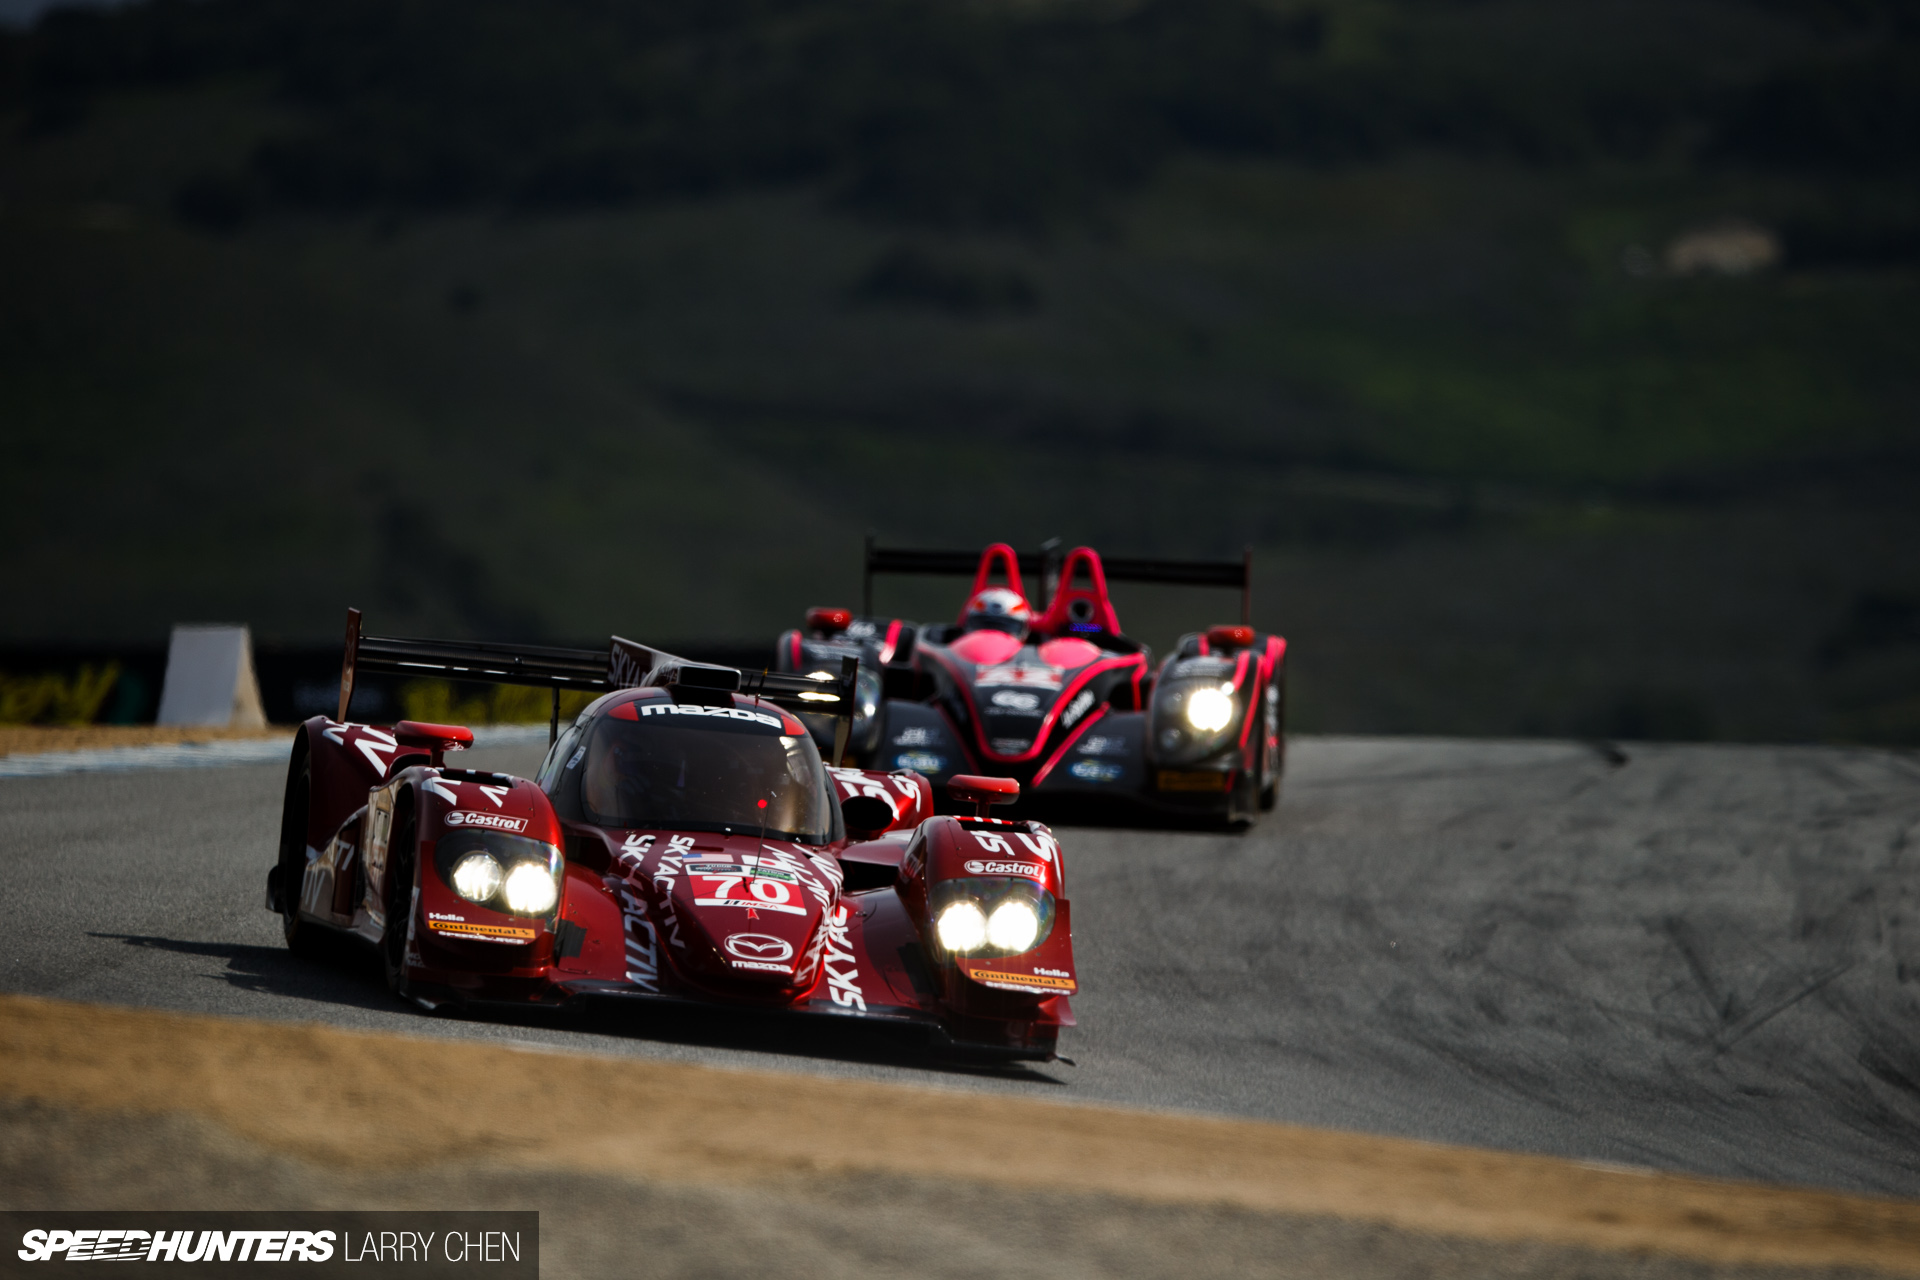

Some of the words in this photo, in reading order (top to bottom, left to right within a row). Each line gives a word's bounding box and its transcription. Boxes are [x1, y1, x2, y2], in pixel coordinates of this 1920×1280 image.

[641, 703, 782, 729] mazda
[464, 812, 521, 830] Castrol
[985, 861, 1039, 877] Castrol
[653, 834, 695, 948] SKYACTIV
[702, 875, 790, 904] 70
[742, 901, 779, 910] IMSA
[428, 912, 465, 921] Hella
[432, 922, 517, 935] Continental
[731, 960, 791, 973] mazda
[1033, 966, 1070, 978] Hella
[973, 970, 1056, 985] Continental
